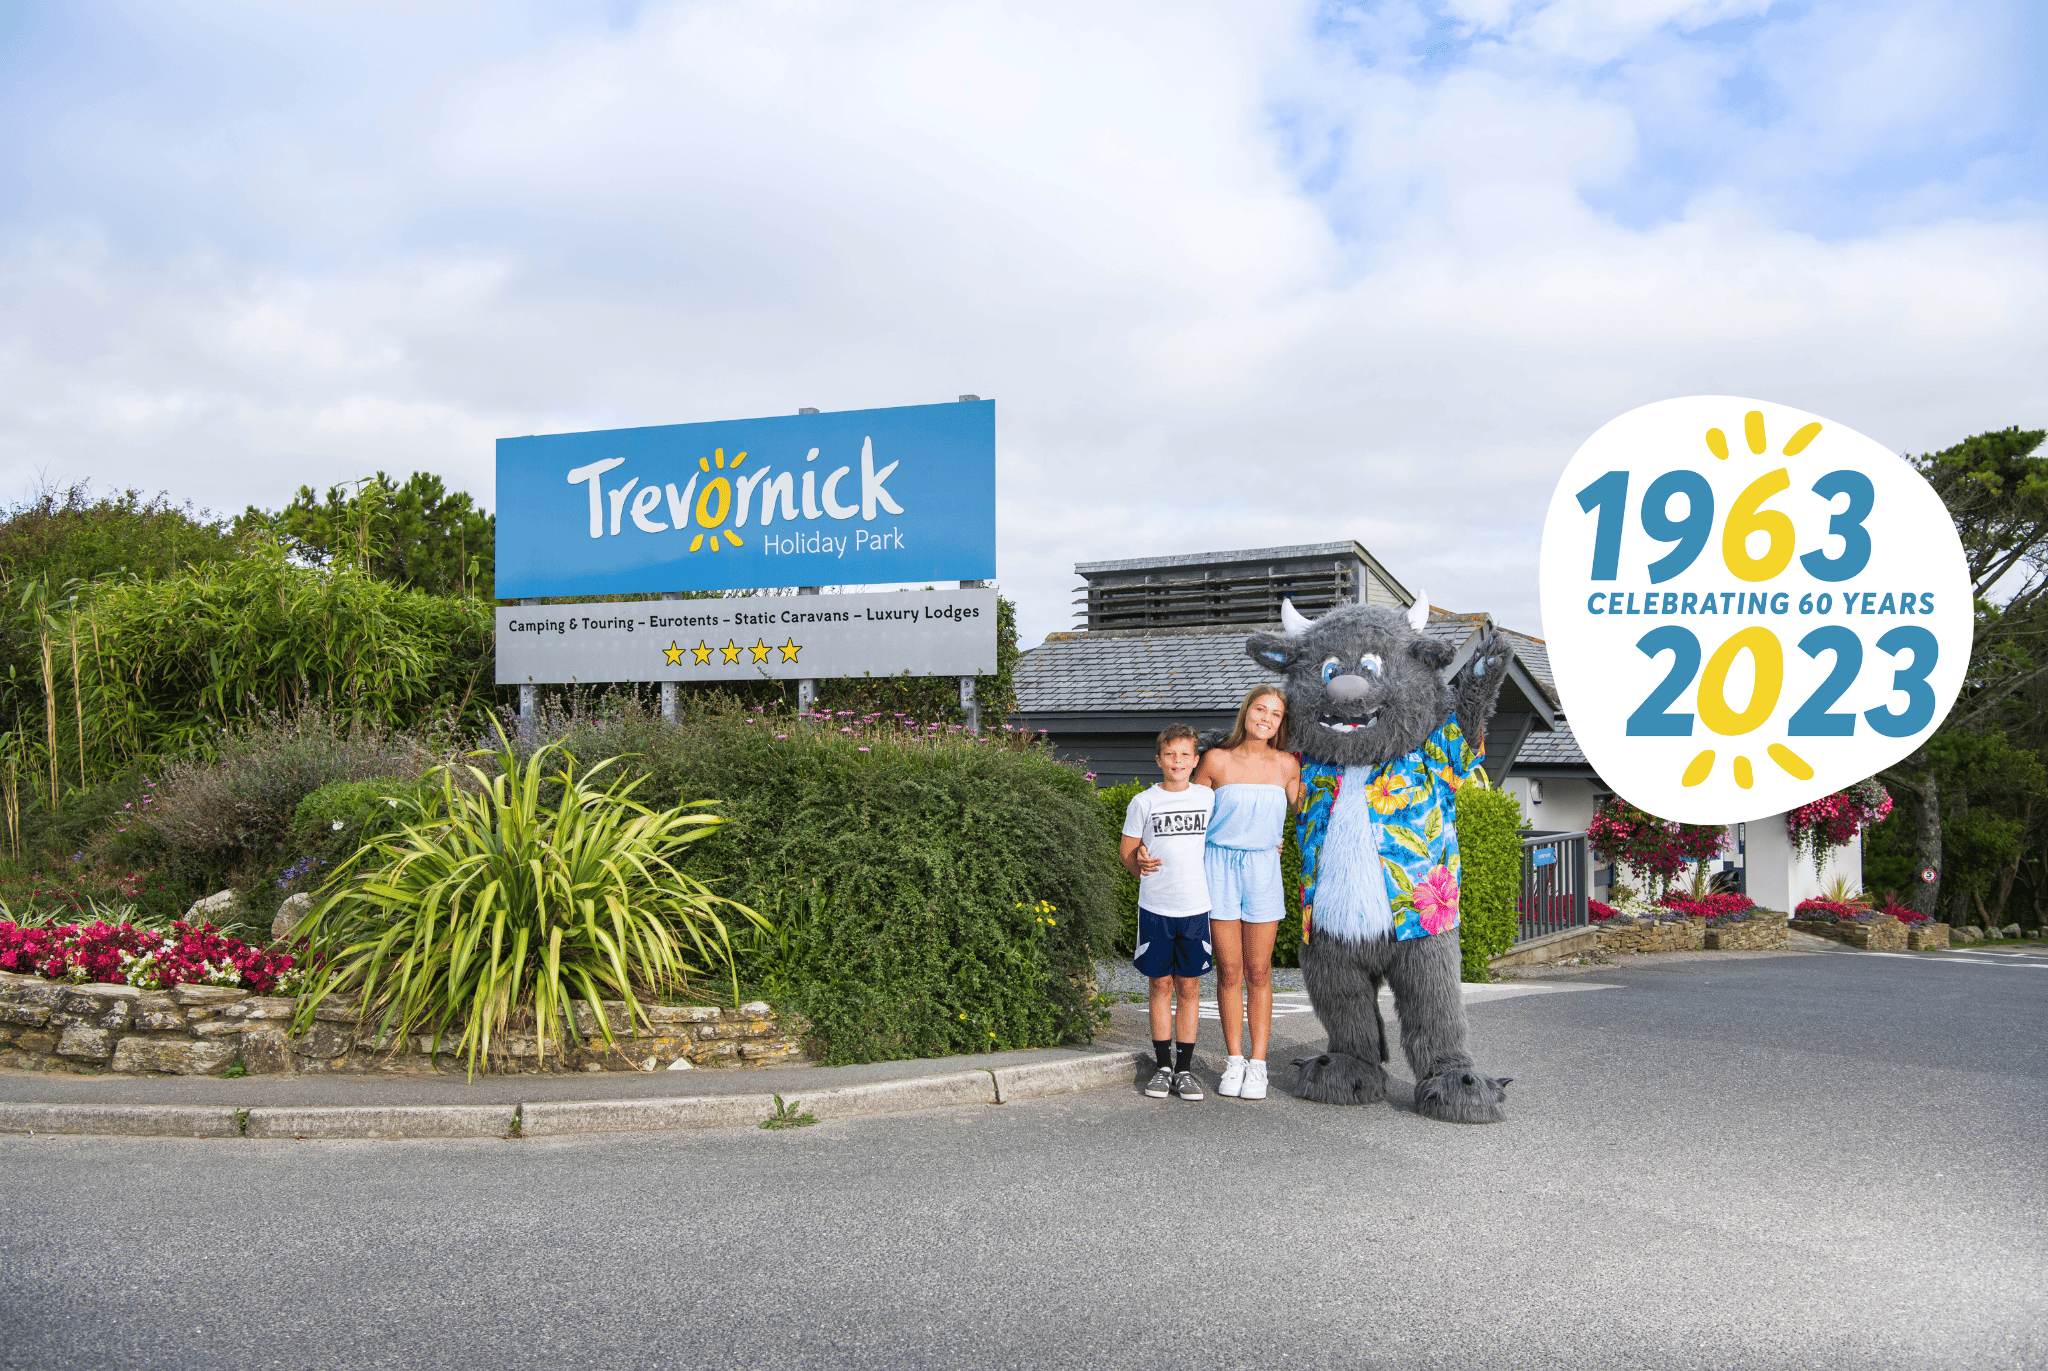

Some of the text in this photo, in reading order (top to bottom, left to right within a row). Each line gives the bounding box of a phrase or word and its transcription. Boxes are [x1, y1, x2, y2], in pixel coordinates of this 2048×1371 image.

[567, 435, 904, 539] Trevornick
[764, 527, 905, 560] Holiday Park
[508, 619, 565, 634] Camping
[569, 618, 578, 630] &
[582, 616, 634, 632] Touring
[650, 614, 719, 628] Eurotents
[734, 611, 776, 625] Static
[781, 610, 849, 624] Caravans
[866, 608, 919, 624] Luxury
[925, 604, 979, 622] Lodges
[1152, 813, 1207, 833] RASCAL
